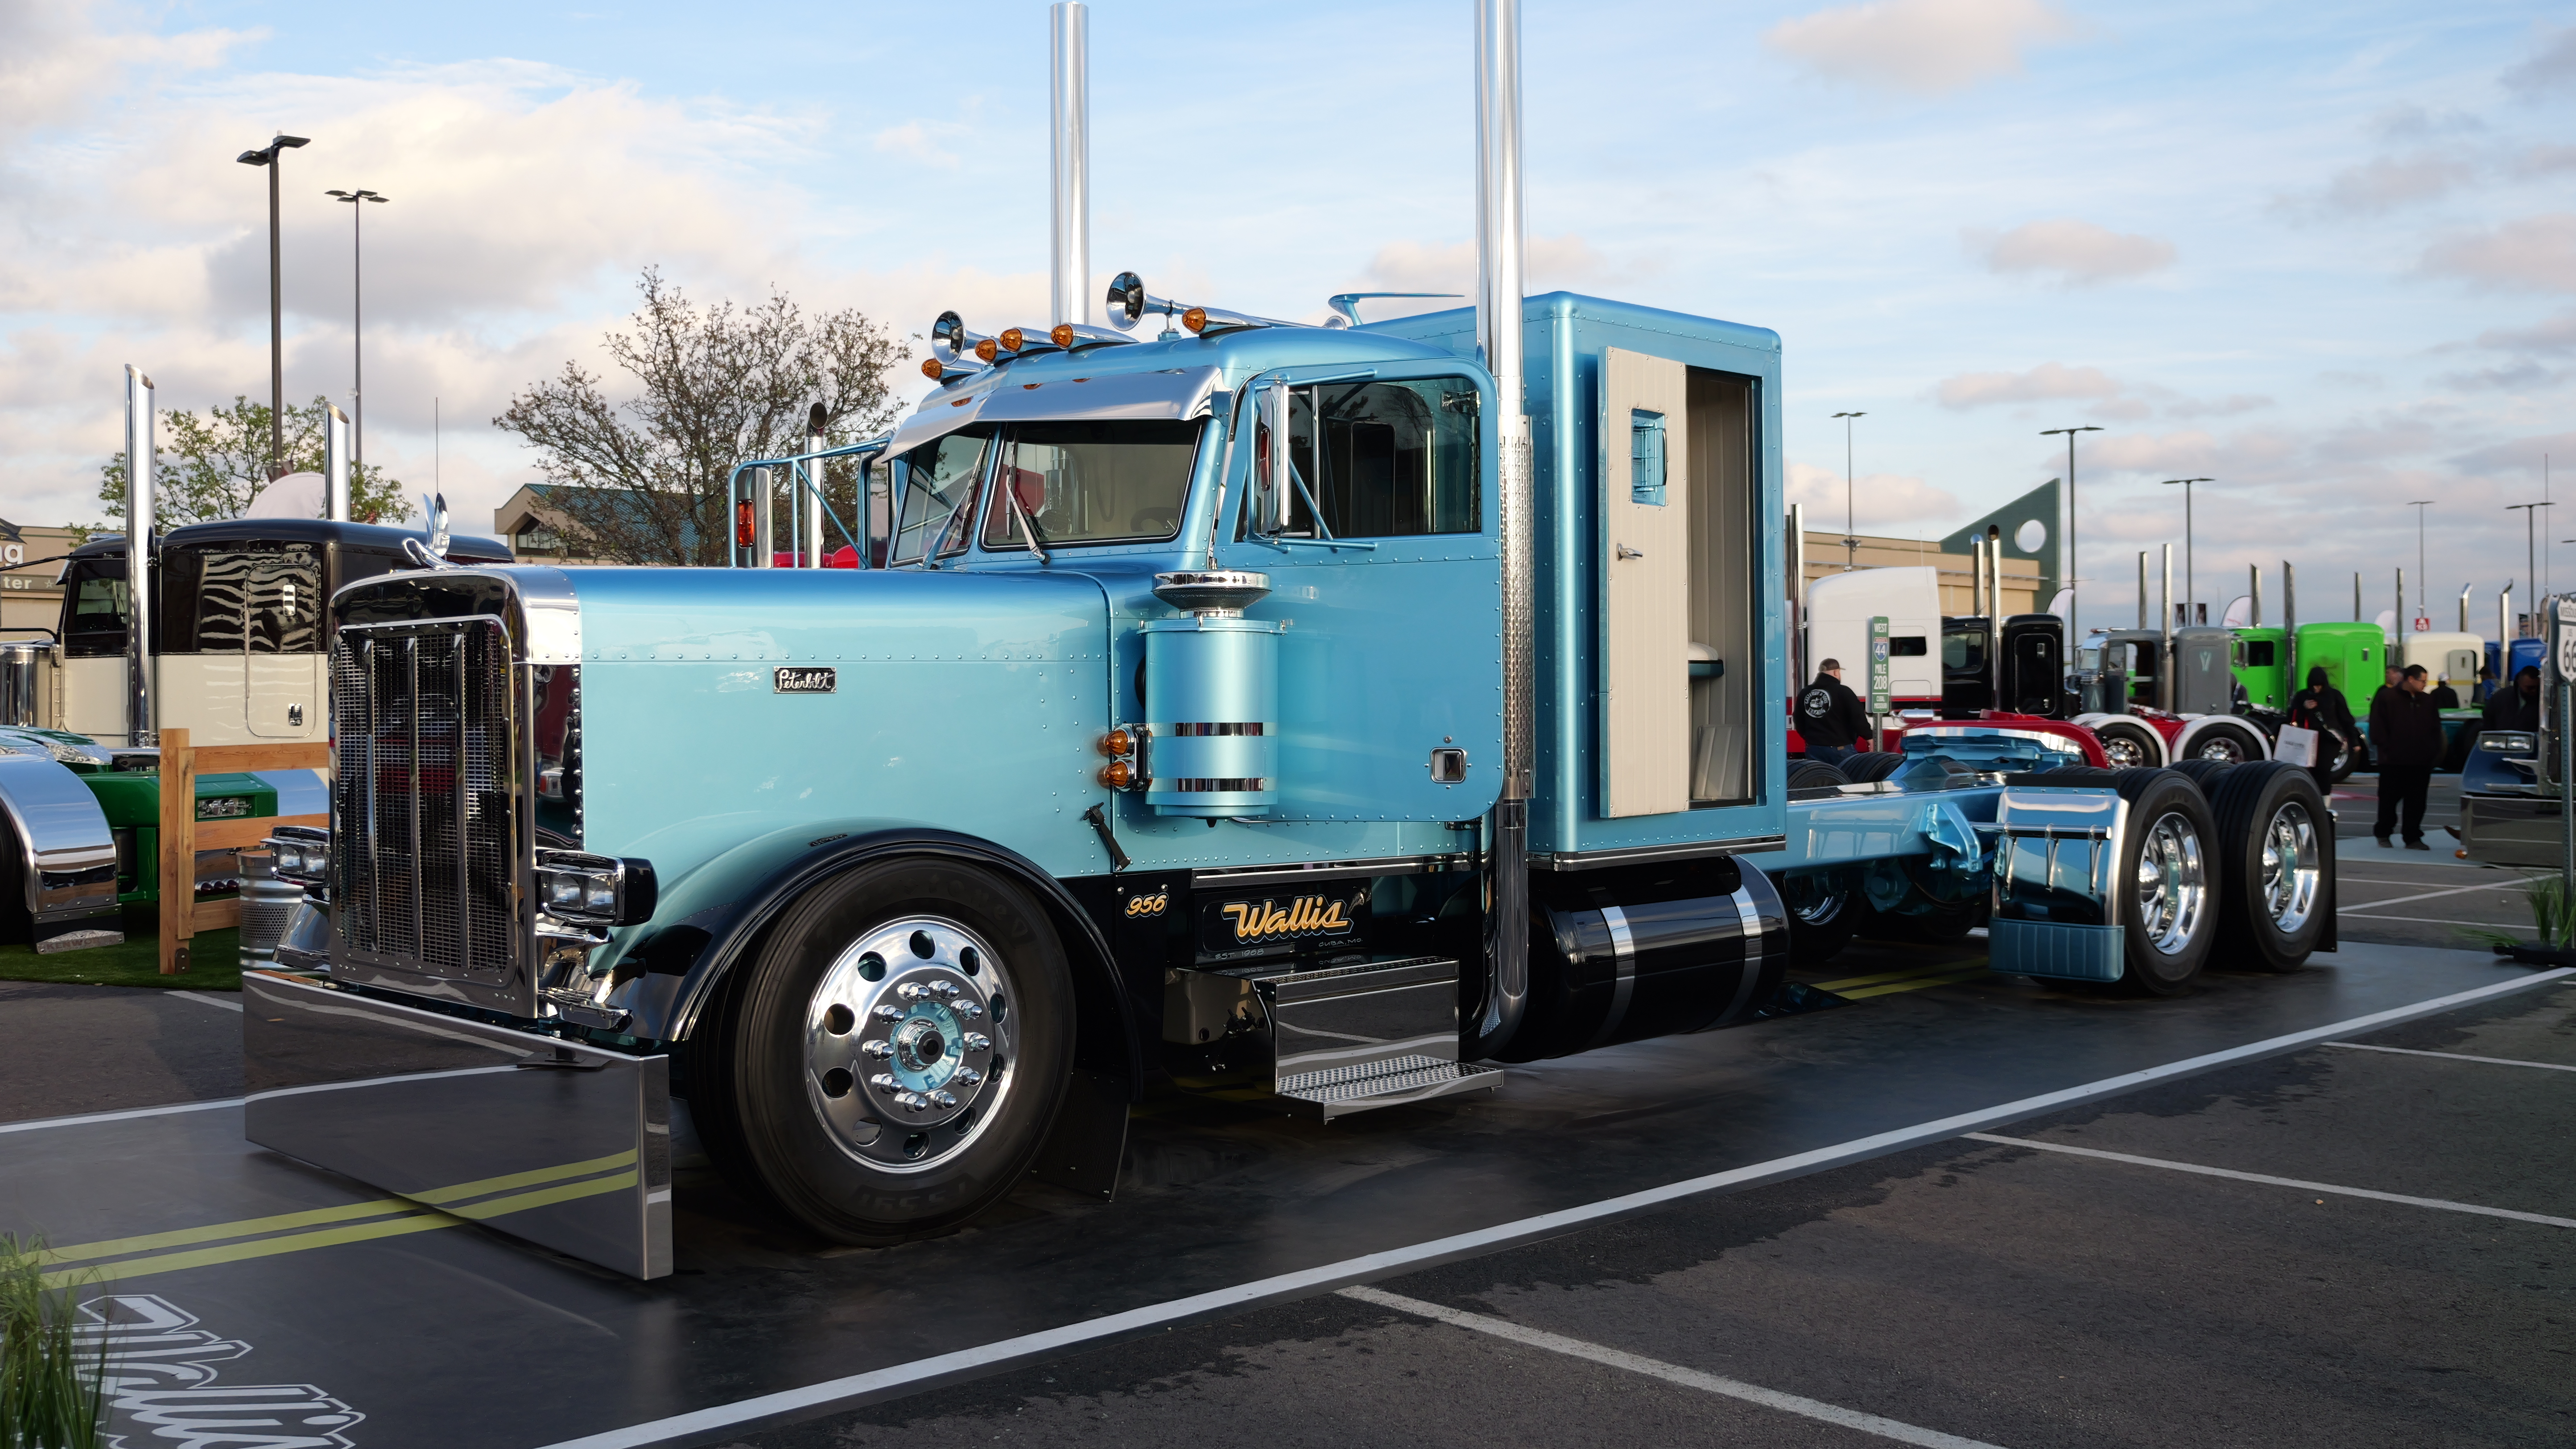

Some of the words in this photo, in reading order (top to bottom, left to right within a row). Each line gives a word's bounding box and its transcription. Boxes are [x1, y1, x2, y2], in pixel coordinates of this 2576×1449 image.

[1874, 623, 1887, 633] WEST
[1875, 645, 1886, 655] 44
[2564, 639, 2576, 673] 66
[1874, 664, 1887, 674] MILE
[779, 669, 834, 690] Peterbilt
[1874, 675, 1887, 690] 208
[1127, 894, 1167, 915] 956
[1223, 896, 1348, 937] Wallis
[1242, 948, 1264, 956] 1968
